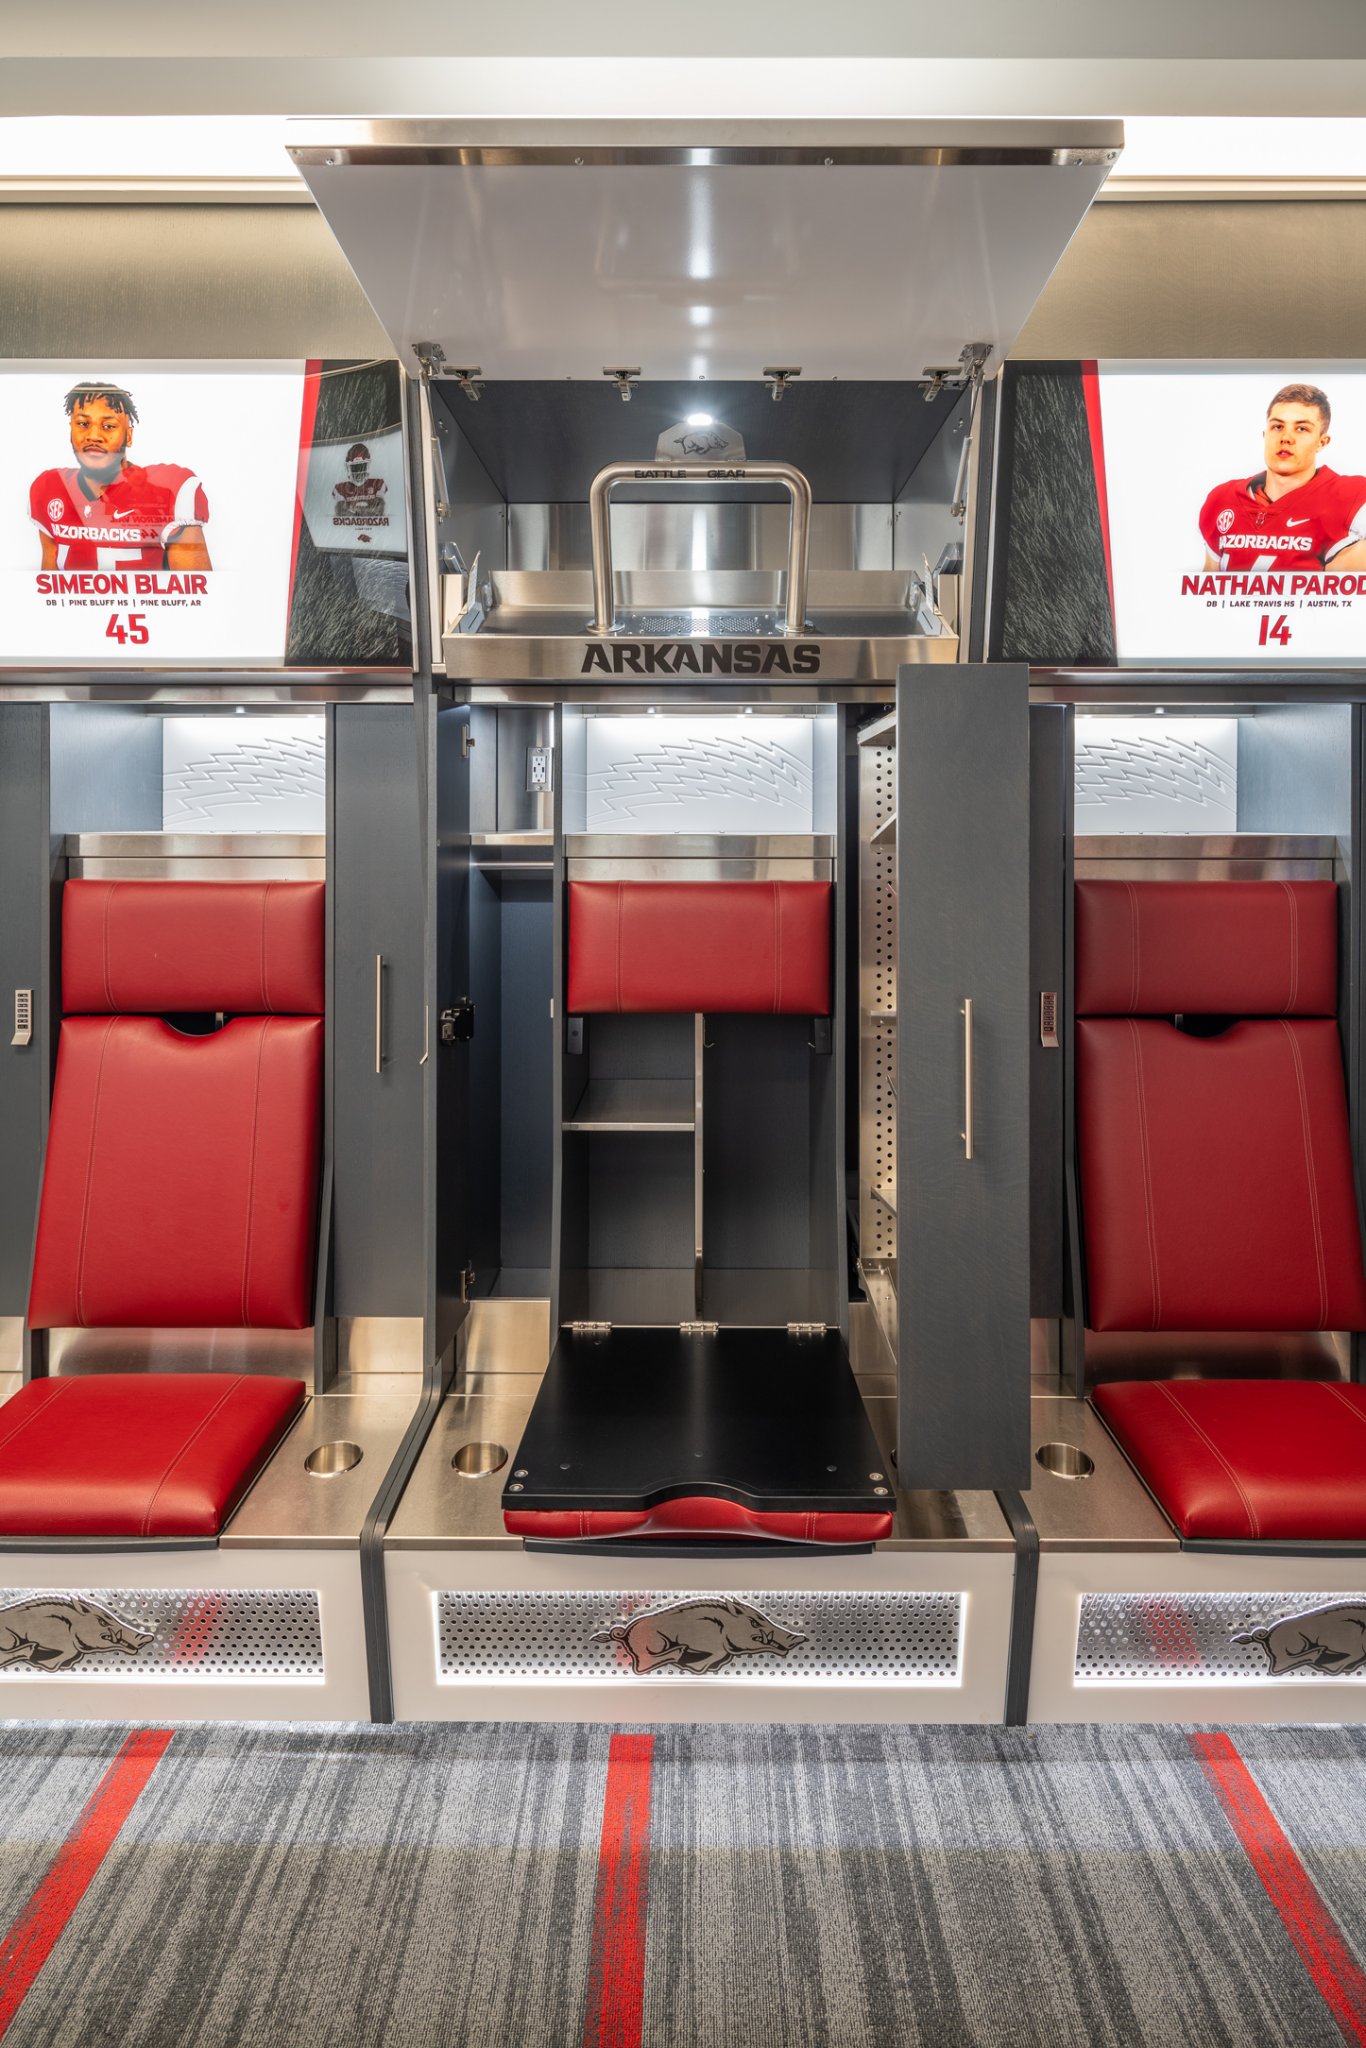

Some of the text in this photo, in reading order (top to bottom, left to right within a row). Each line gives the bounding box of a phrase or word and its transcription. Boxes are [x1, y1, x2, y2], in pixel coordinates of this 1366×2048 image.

[634, 469, 746, 479] BATTLE GEAR
[48, 500, 64, 520] SEC
[1217, 510, 1235, 532] SEC
[36, 573, 208, 595] SIMEON BLAIR
[1181, 575, 1285, 596] NATHAN
[46, 599, 202, 607] DB PINE BLUFF HS PINE BLUFF, AR
[1206, 600, 1353, 609] DB LAKE TRAVIS HS AUSTIN, TX
[105, 613, 150, 645] 45
[1258, 614, 1293, 646] 14
[580, 643, 821, 674] ARKANSAS
